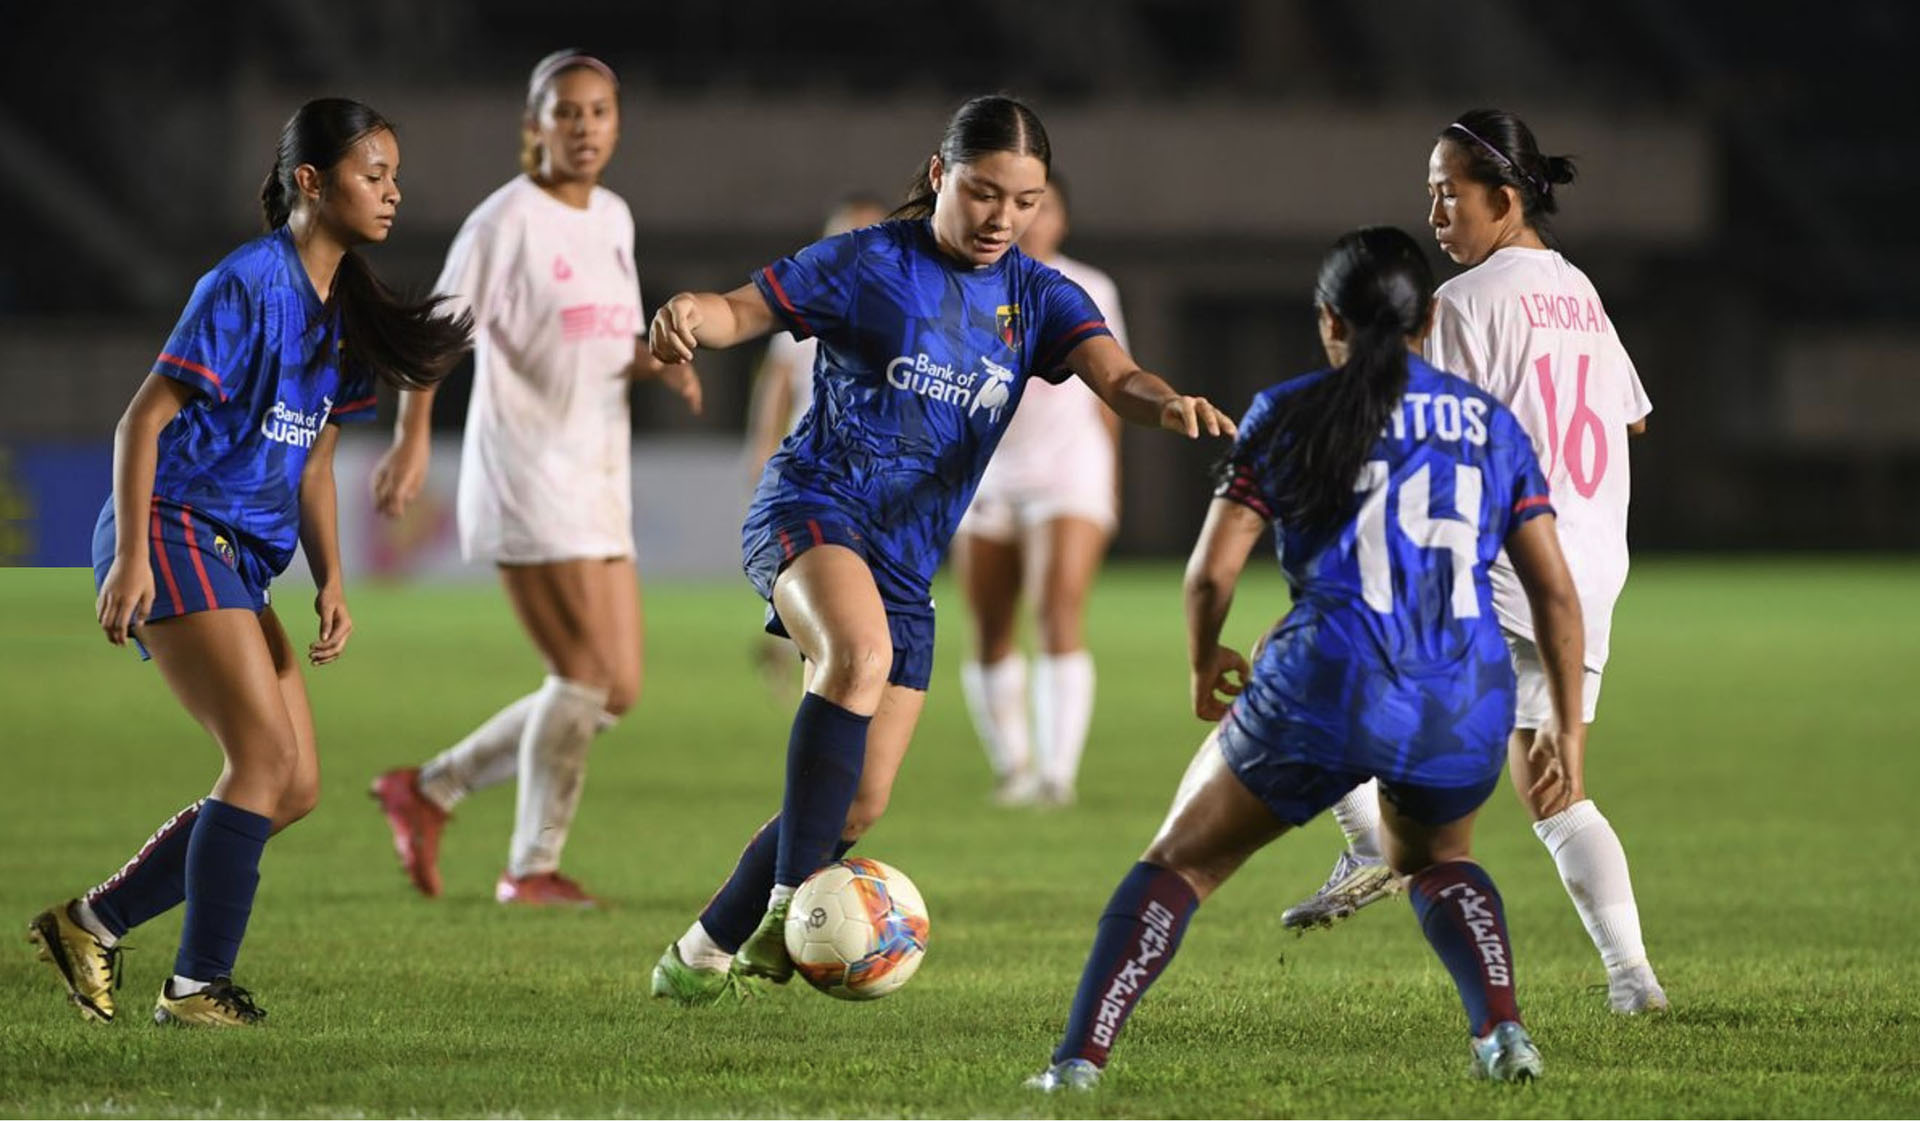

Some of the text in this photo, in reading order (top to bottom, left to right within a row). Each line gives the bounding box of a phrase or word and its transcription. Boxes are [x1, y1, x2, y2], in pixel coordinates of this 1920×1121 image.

[886, 355, 971, 408] Guam
[914, 352, 979, 388] Bank of
[275, 400, 319, 429] Bank of
[1534, 352, 1609, 500] 16
[1352, 460, 1483, 618] 14
